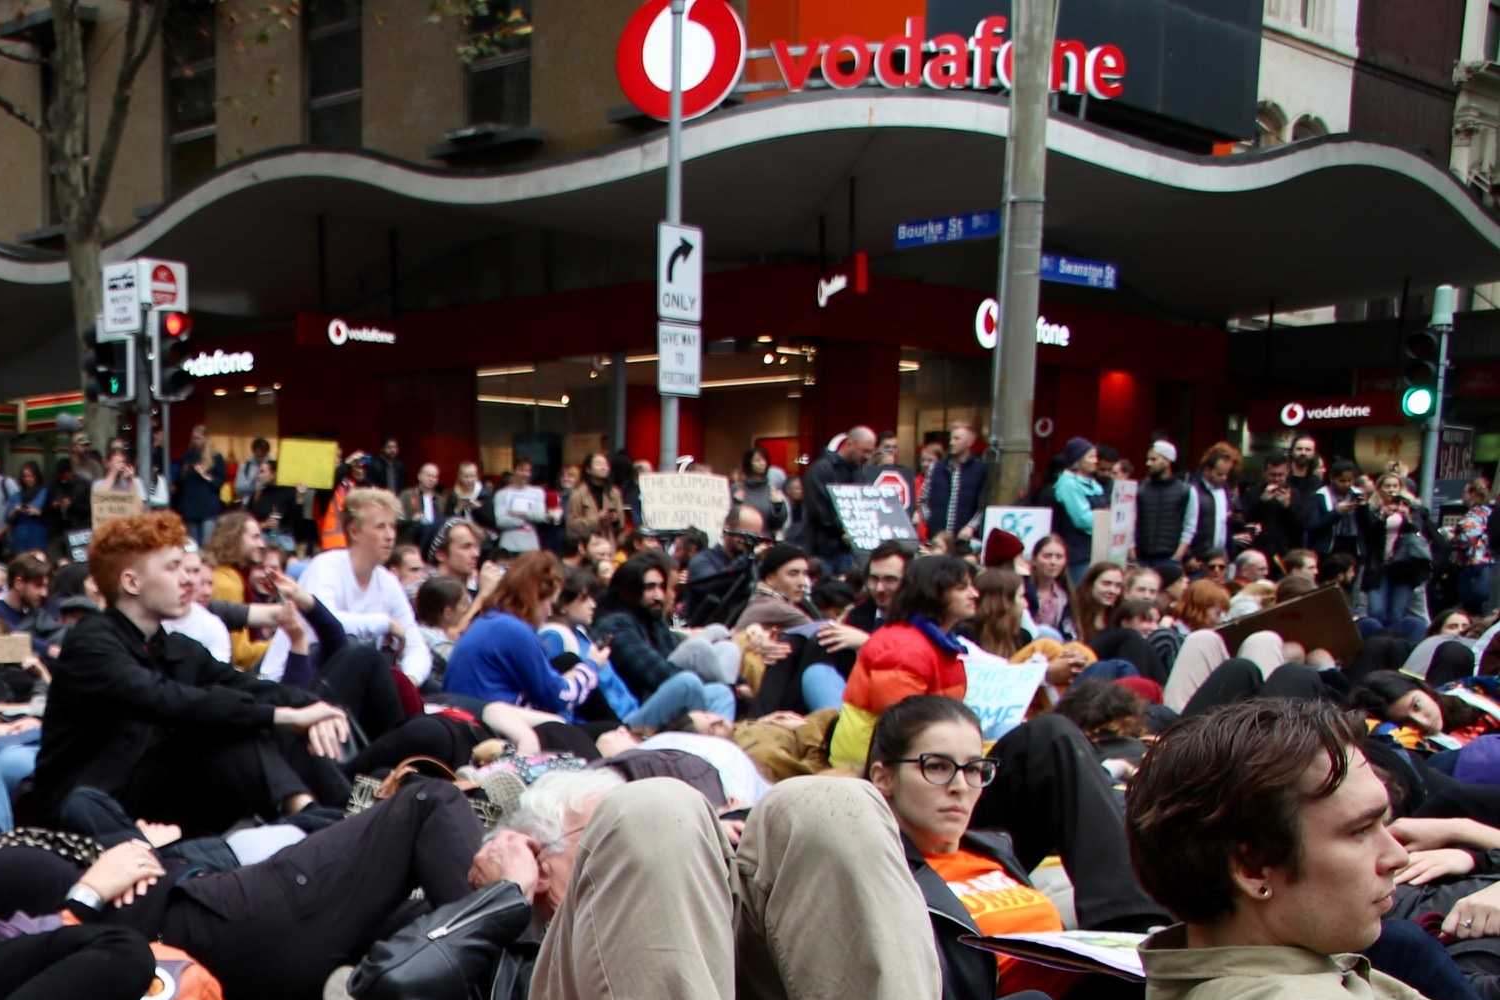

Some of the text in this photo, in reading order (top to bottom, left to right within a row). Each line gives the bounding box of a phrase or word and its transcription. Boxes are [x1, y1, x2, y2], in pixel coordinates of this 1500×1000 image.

[770, 15, 1127, 100] vodafne
[897, 220, 943, 240] Bourke
[949, 217, 963, 233] St
[662, 293, 696, 311] ONLY
[660, 332, 679, 346] GIVE
[1036, 315, 1070, 347] fone
[1306, 403, 1371, 419] vodafone
